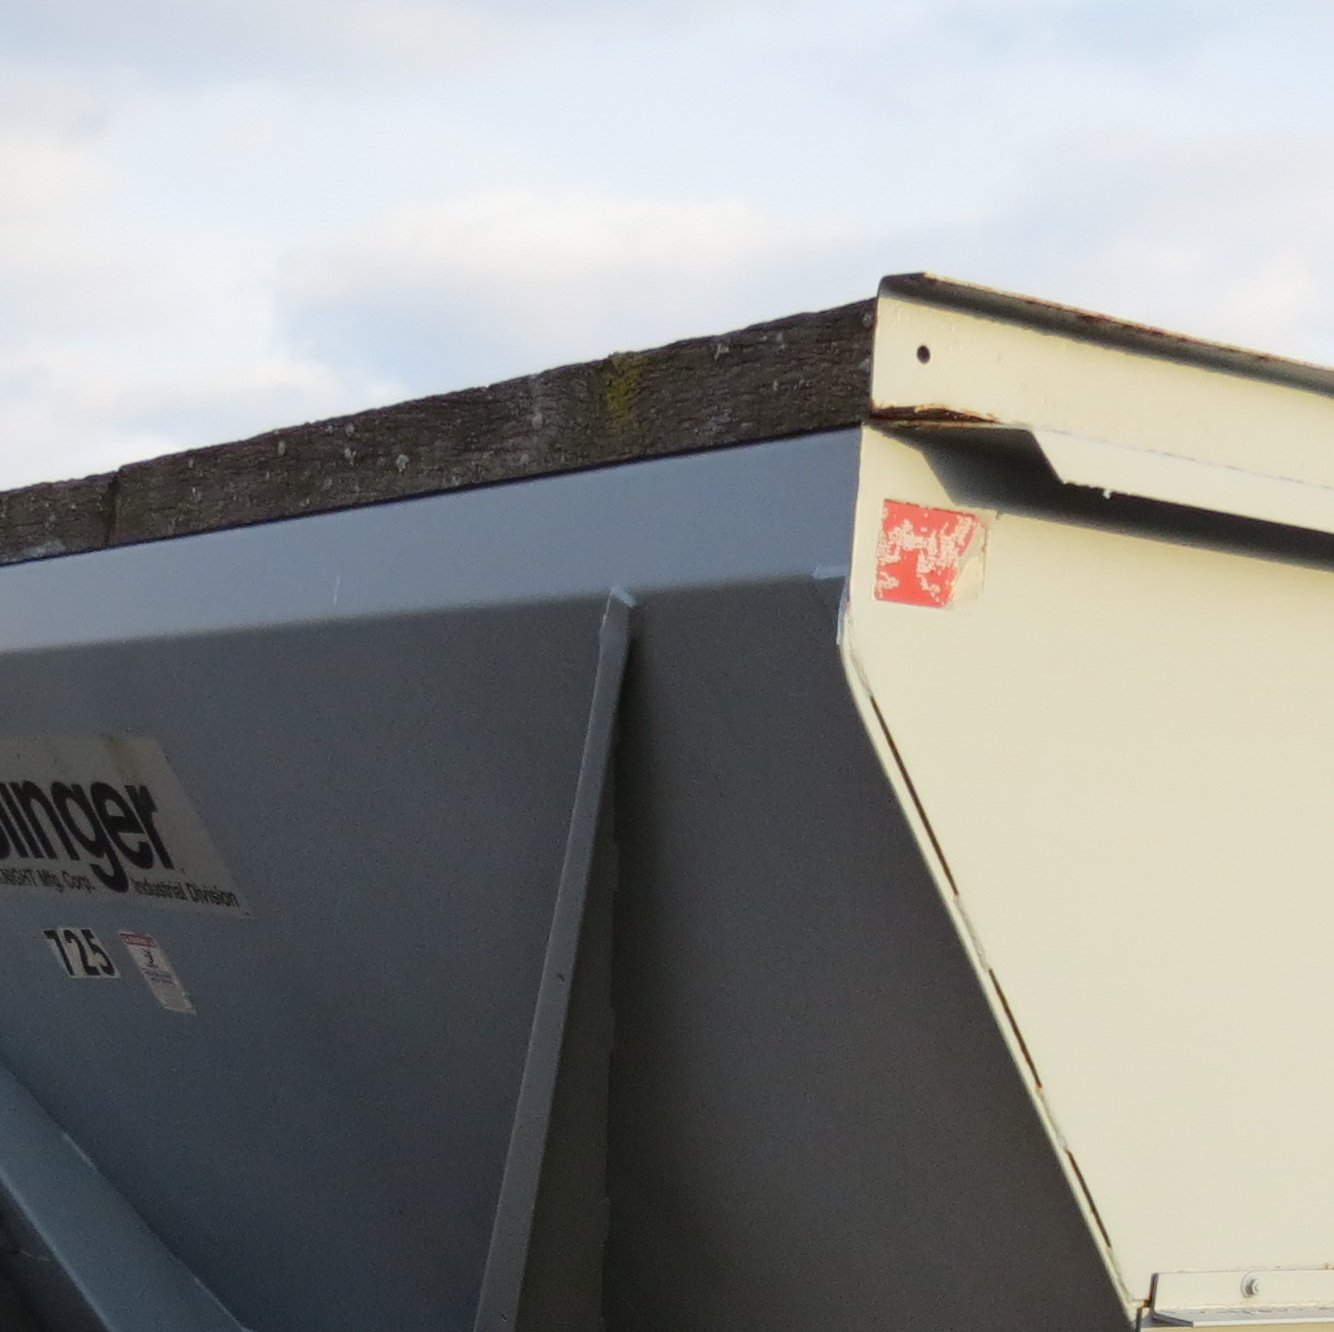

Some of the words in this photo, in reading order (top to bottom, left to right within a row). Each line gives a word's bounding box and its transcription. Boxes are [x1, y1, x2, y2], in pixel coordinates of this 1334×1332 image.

[130, 878, 189, 901] Industrial
[185, 882, 240, 908] Division
[43, 929, 116, 977] 725
